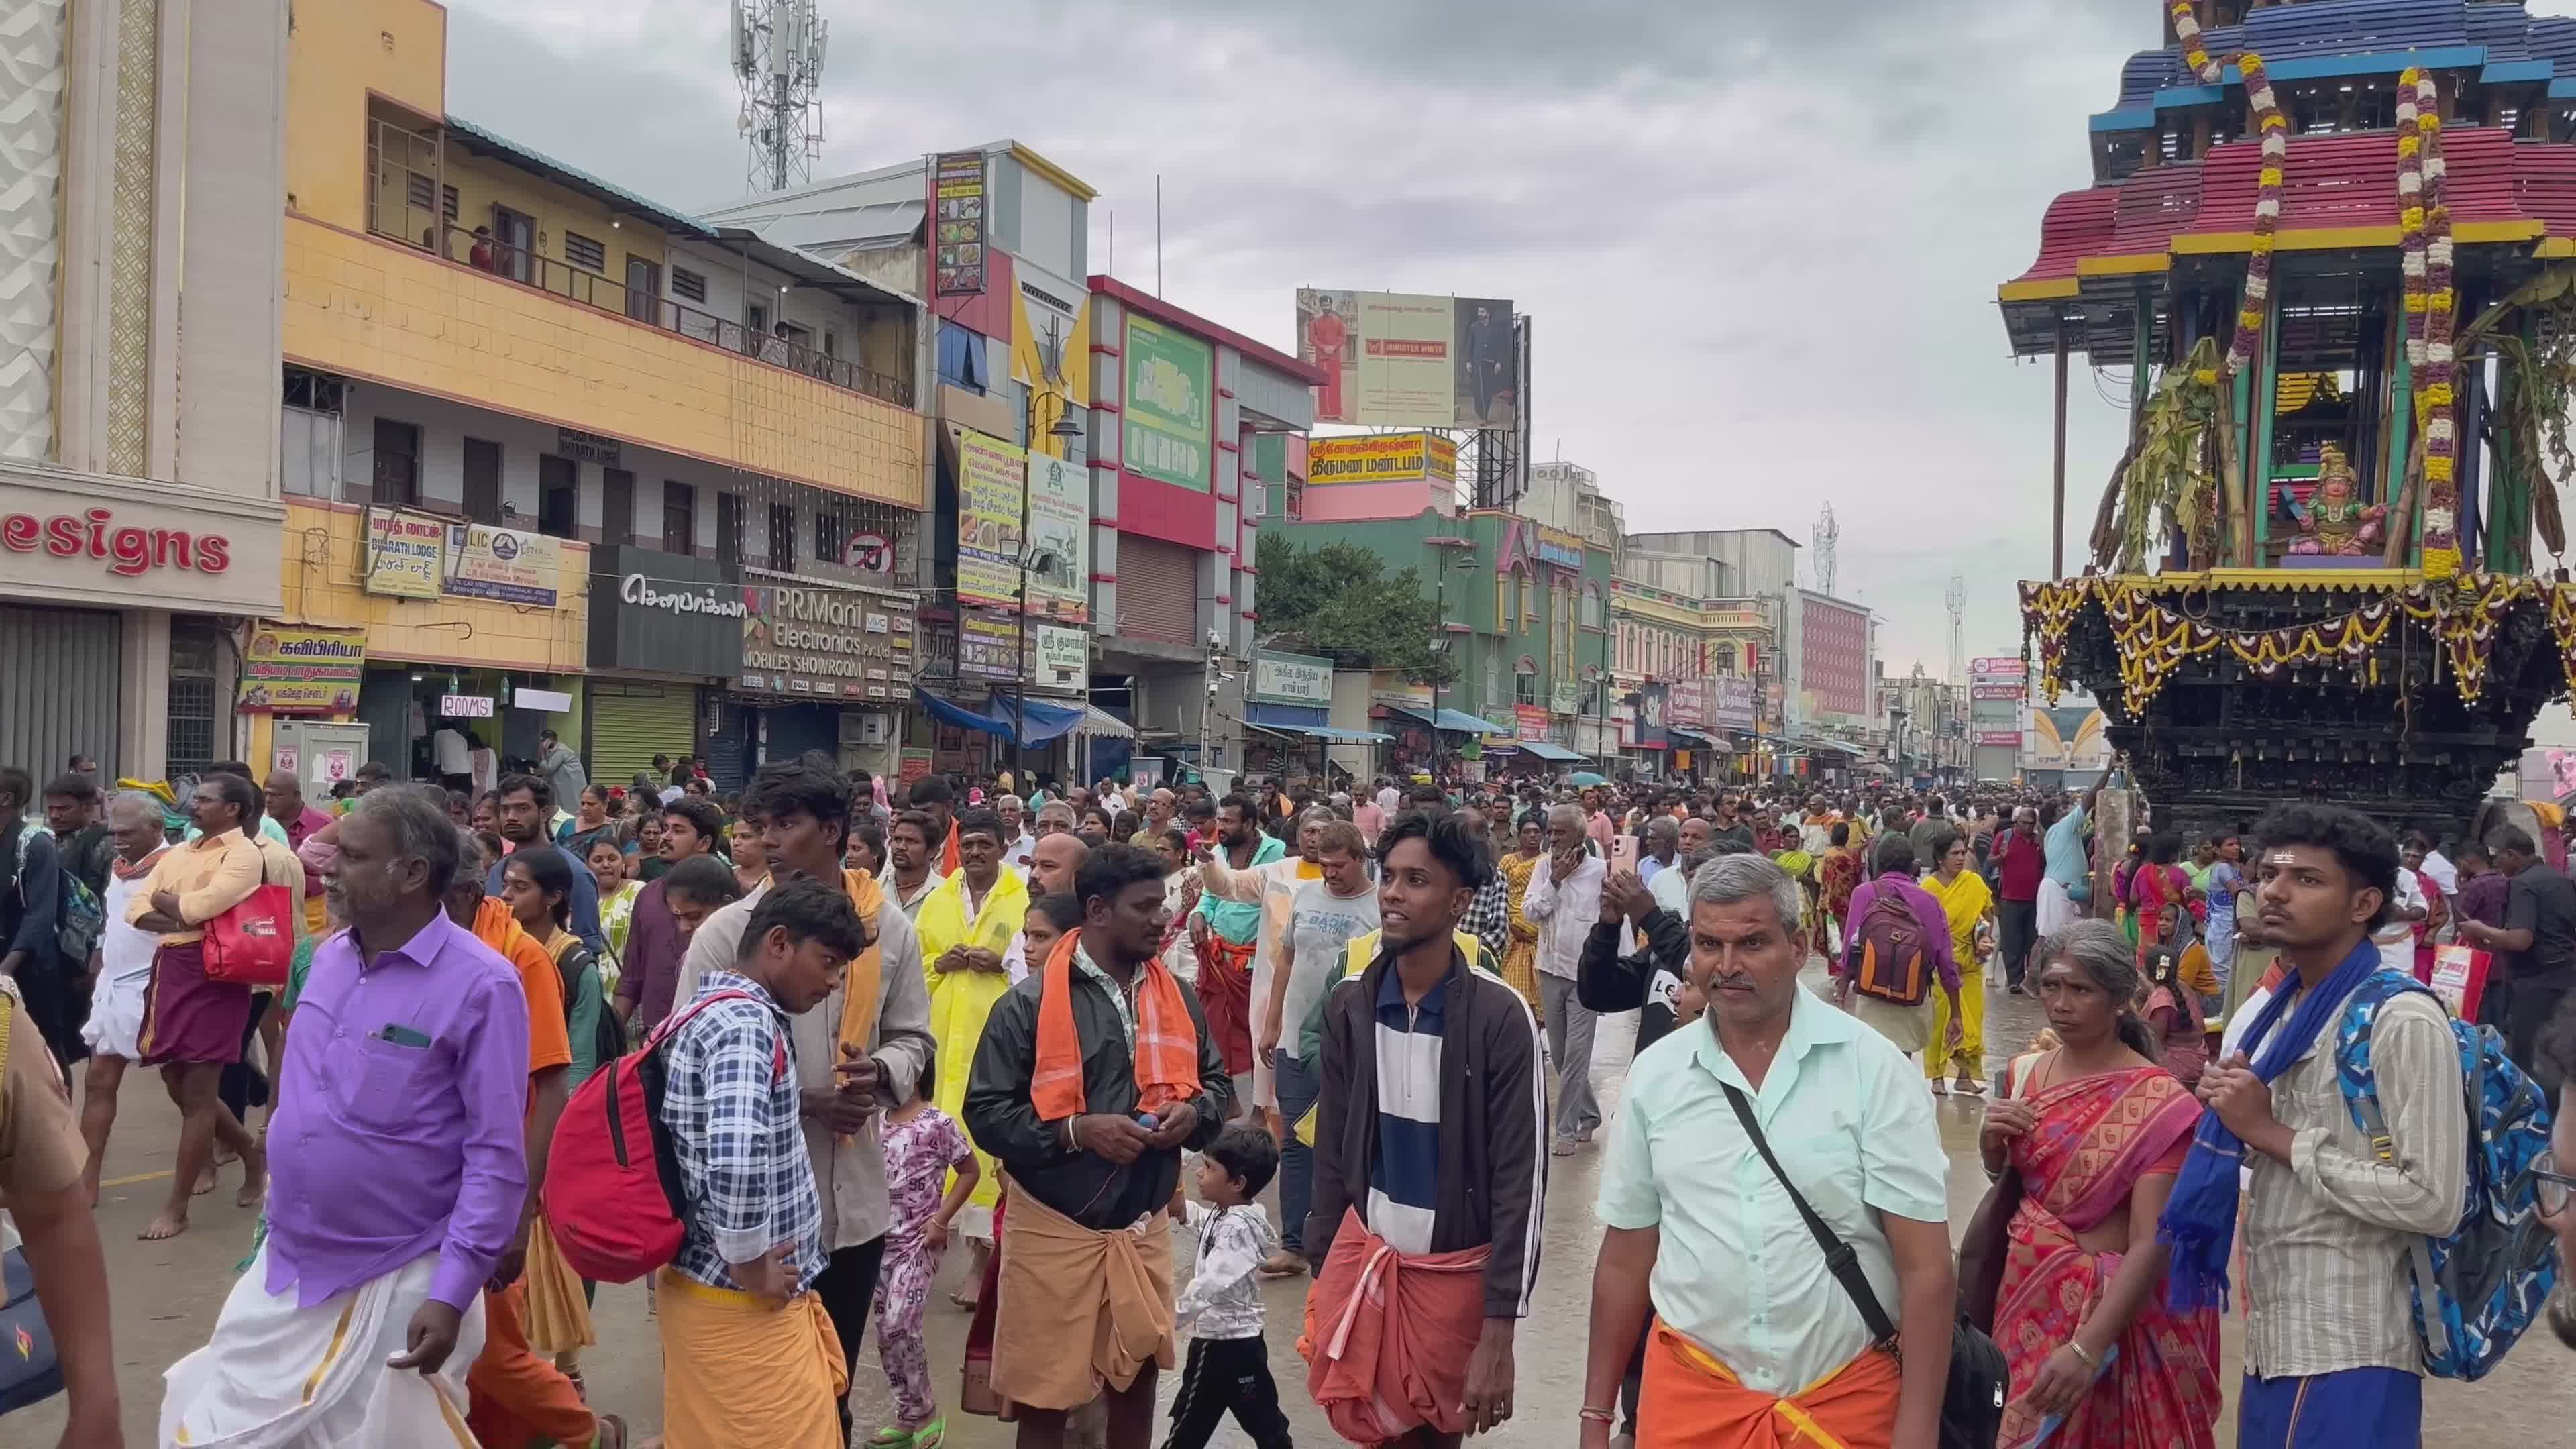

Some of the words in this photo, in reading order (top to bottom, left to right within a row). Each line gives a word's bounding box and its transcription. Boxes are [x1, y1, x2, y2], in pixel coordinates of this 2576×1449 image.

[373, 517, 402, 535] பாத்
[470, 531, 488, 548] LIC
[412, 542, 437, 559] LODGE
[775, 621, 861, 655] Electronics
[279, 638, 364, 658] கவிபிரியா
[742, 650, 791, 670] MOBILES
[794, 655, 861, 678] SHOWROOM
[444, 696, 488, 716] ROOMS
[908, 1178, 926, 1191] 96
[906, 1288, 923, 1305] 96
